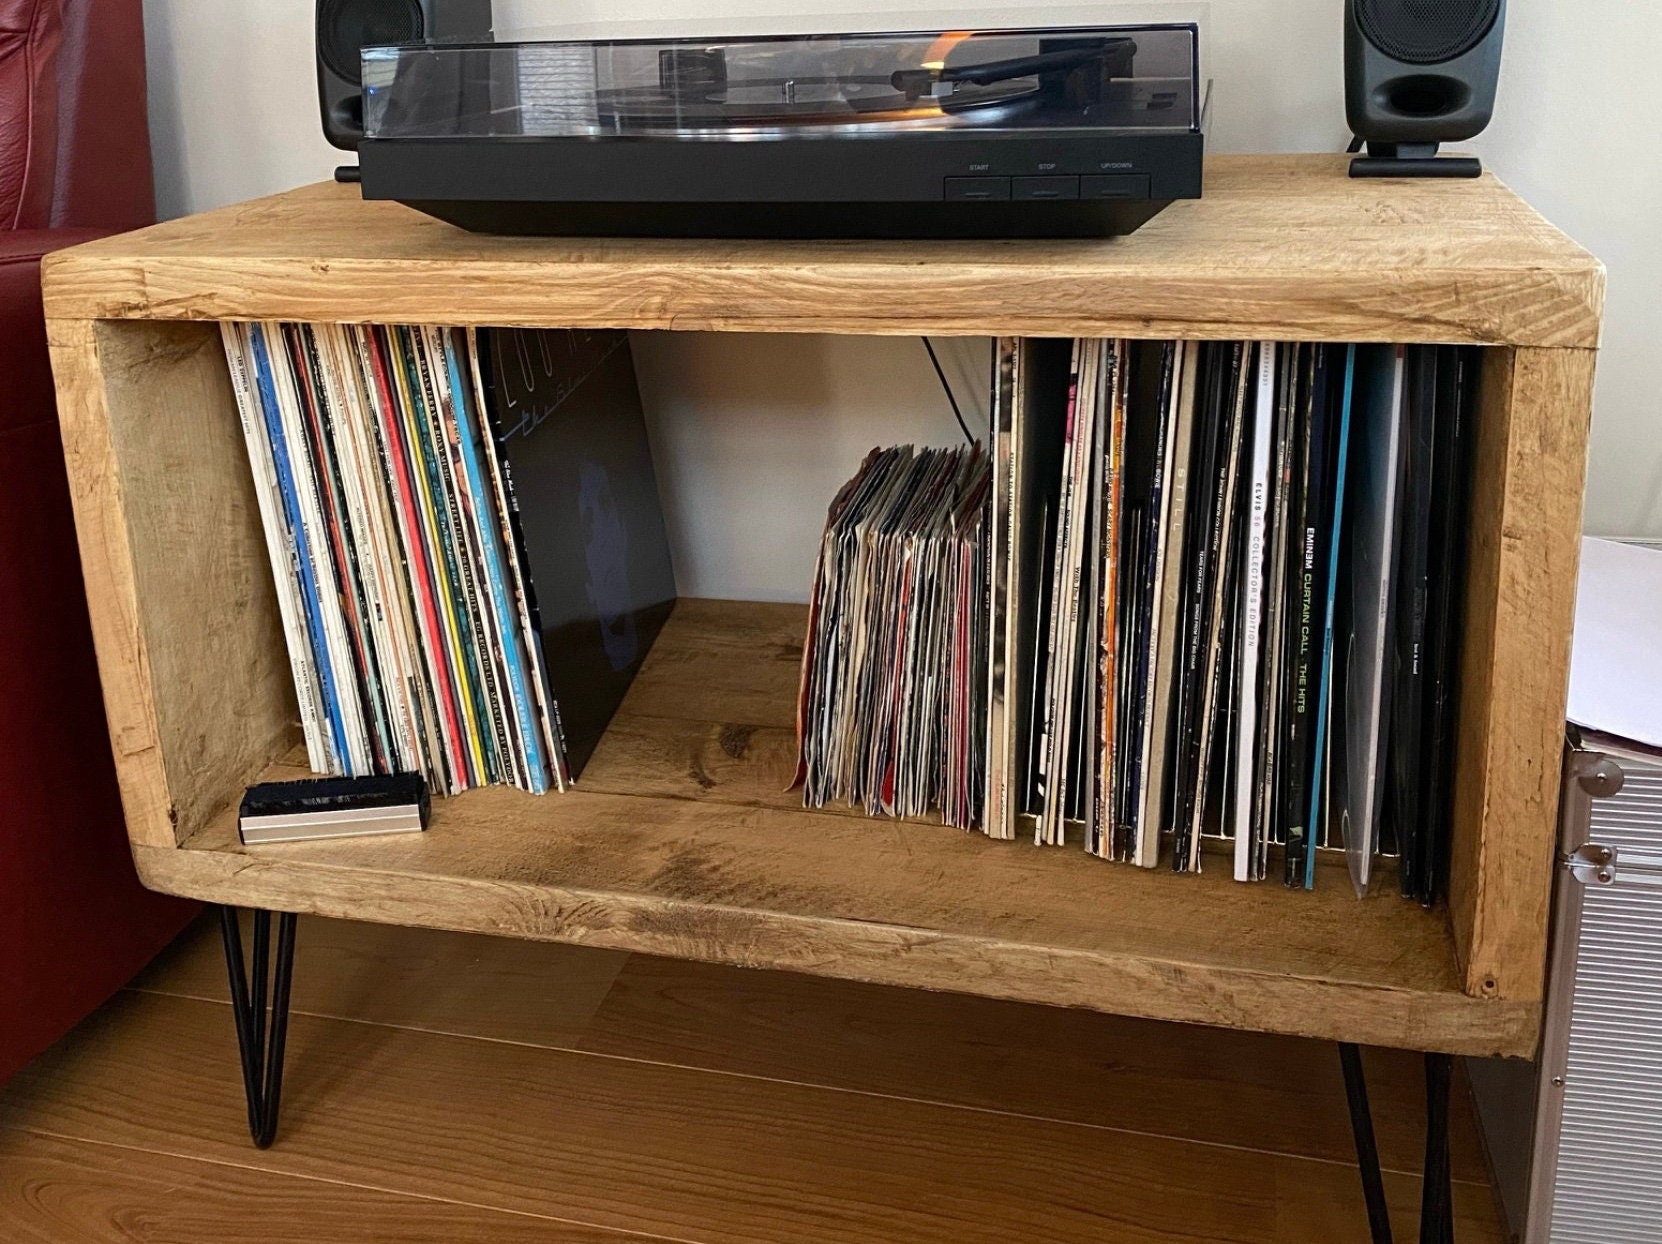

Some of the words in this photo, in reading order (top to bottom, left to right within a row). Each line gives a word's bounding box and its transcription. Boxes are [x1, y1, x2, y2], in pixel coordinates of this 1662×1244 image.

[239, 367, 249, 392] ZEPPELIN
[419, 359, 431, 387] BRYAN
[238, 394, 248, 421] GREATEST
[425, 387, 437, 417] FERRY
[434, 429, 445, 453] ROXY
[440, 454, 452, 482] MUSIC
[1009, 481, 1013, 489] TO
[1255, 482, 1263, 511] ELVIS
[448, 492, 460, 522] STREET
[1172, 467, 1186, 532] STILL
[454, 524, 464, 544] LIFE
[1211, 517, 1220, 551] COLLECTION
[304, 528, 314, 557] Collection
[311, 563, 319, 585] Beatles
[1250, 536, 1260, 604] COLLECTOR'S
[463, 561, 474, 591] GREAT
[469, 592, 479, 613] HITS
[1070, 599, 1078, 622] Beatles
[1302, 573, 1312, 623] CURTAIN
[475, 620, 483, 631] EG
[1248, 608, 1256, 648] EDITION
[478, 632, 491, 670] RECORDS
[1300, 626, 1309, 655] CALL
[296, 675, 304, 699] RECORDS
[300, 660, 309, 684] ATLANTIC
[305, 685, 314, 707] RECORDS
[486, 670, 495, 688] LTD
[1298, 663, 1307, 686] THE
[490, 689, 505, 734] MARKETED
[1296, 688, 1306, 713] HITS
[500, 734, 507, 745] BY
[502, 746, 516, 783] POLYDOR
